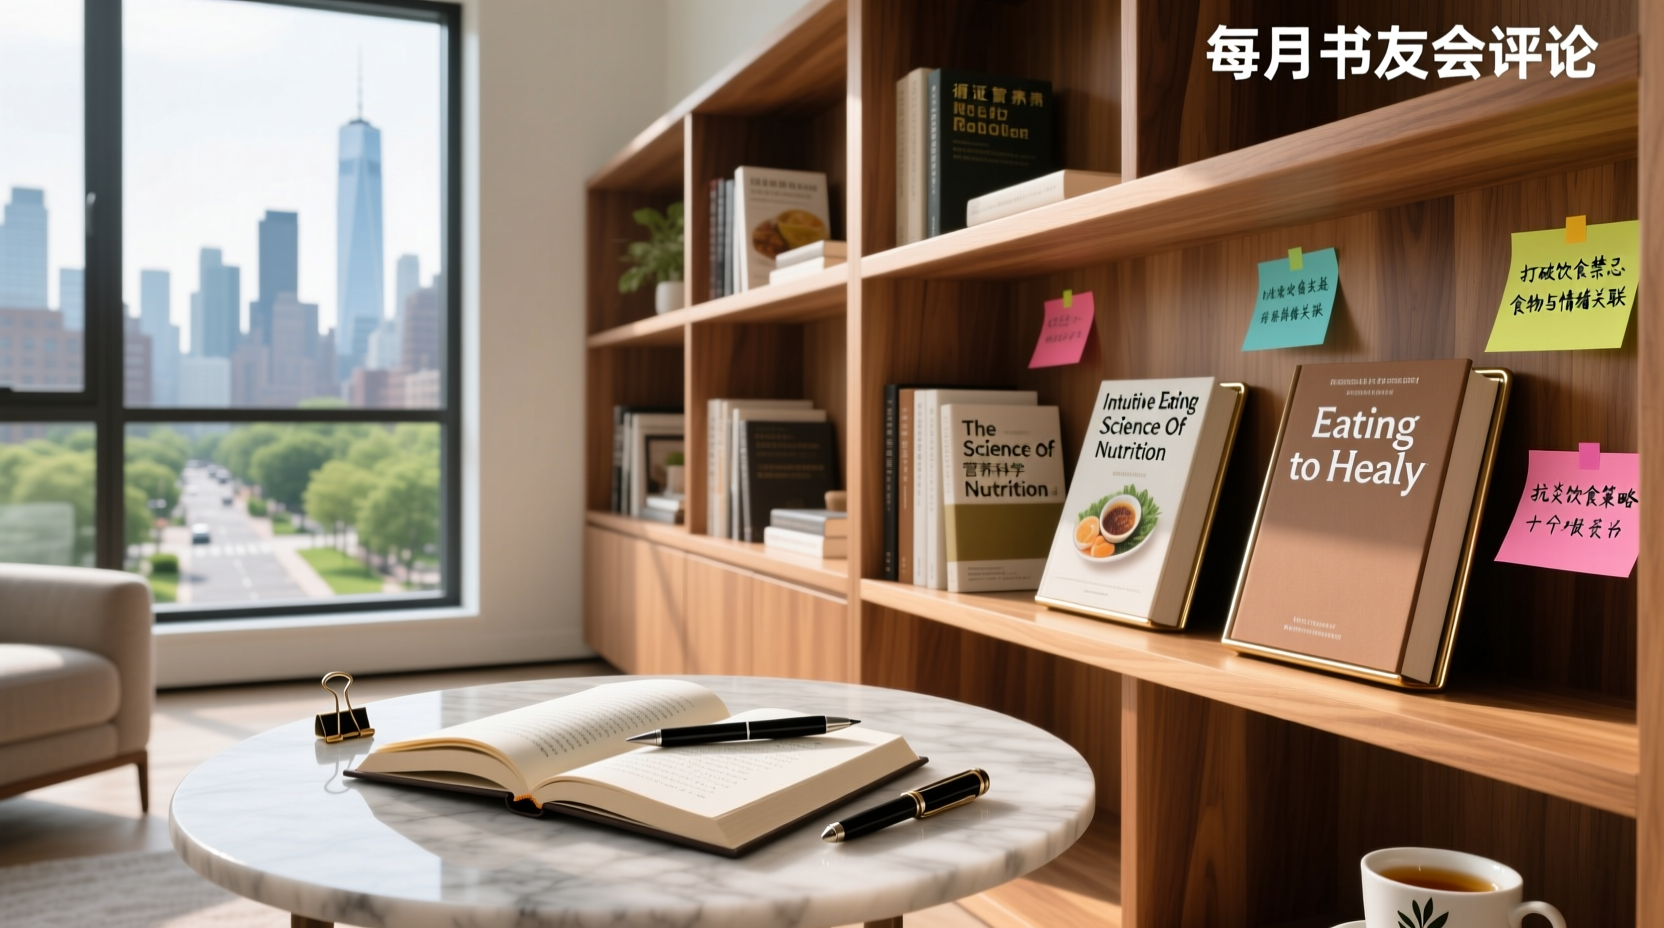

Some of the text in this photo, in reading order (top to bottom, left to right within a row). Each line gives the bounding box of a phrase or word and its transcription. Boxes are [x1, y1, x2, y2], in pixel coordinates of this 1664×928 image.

[1520, 255, 1626, 283] 打破饮食禁忌
[962, 420, 996, 436] The
[1099, 416, 1187, 436] Science Of
[1311, 406, 1420, 451] Eating
[963, 439, 1031, 457] Science
[1095, 440, 1166, 461] Nutrition
[1289, 450, 1427, 497] to Healy
[965, 480, 1048, 497] Nutrition
